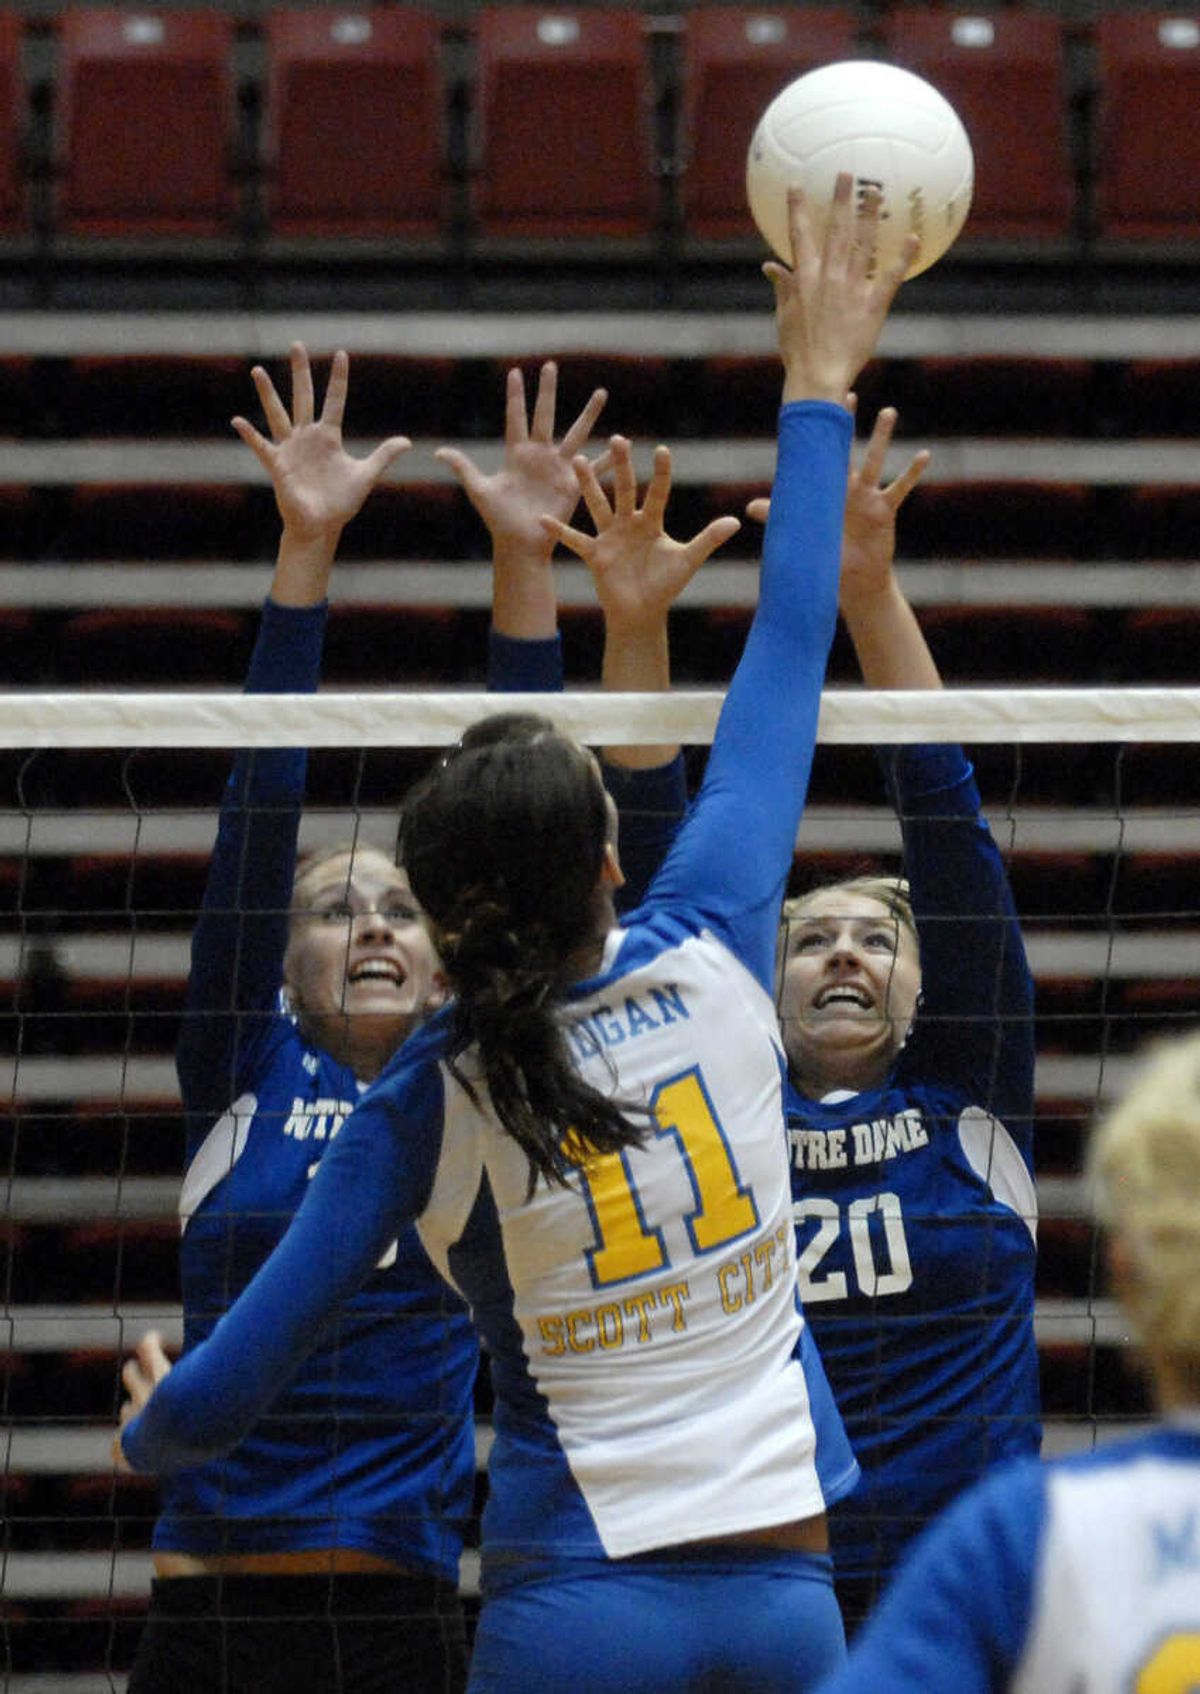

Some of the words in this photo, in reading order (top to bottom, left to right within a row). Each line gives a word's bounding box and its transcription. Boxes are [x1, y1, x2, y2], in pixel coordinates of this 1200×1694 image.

[567, 982, 690, 1066] OGAN
[556, 1062, 762, 1290] 11
[786, 1128, 848, 1170] TRE
[793, 1191, 914, 1303] 20
[537, 1281, 690, 1357] SCOTT
